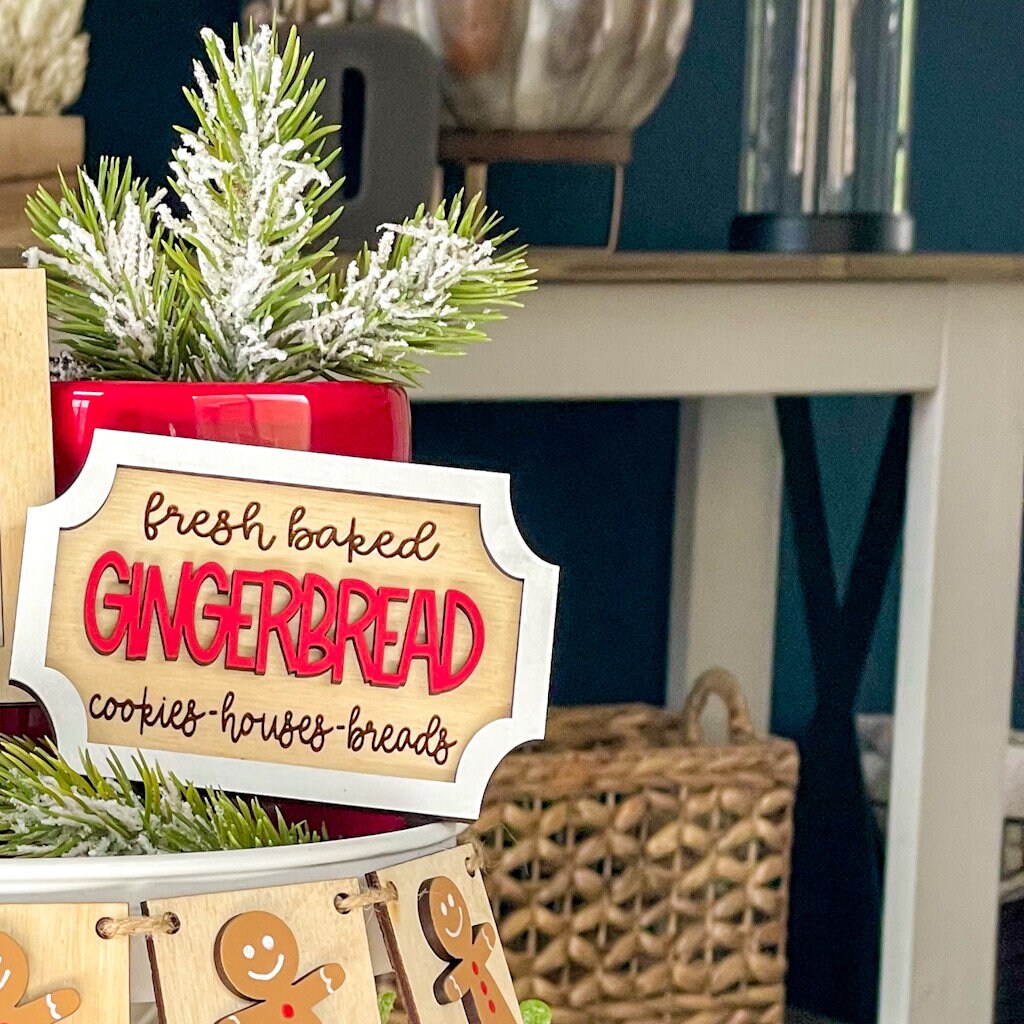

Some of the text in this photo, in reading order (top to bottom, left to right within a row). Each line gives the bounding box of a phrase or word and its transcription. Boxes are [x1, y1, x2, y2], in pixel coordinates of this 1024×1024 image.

[143, 491, 440, 562] fresh baked
[84, 550, 485, 695] GINGERBREAD
